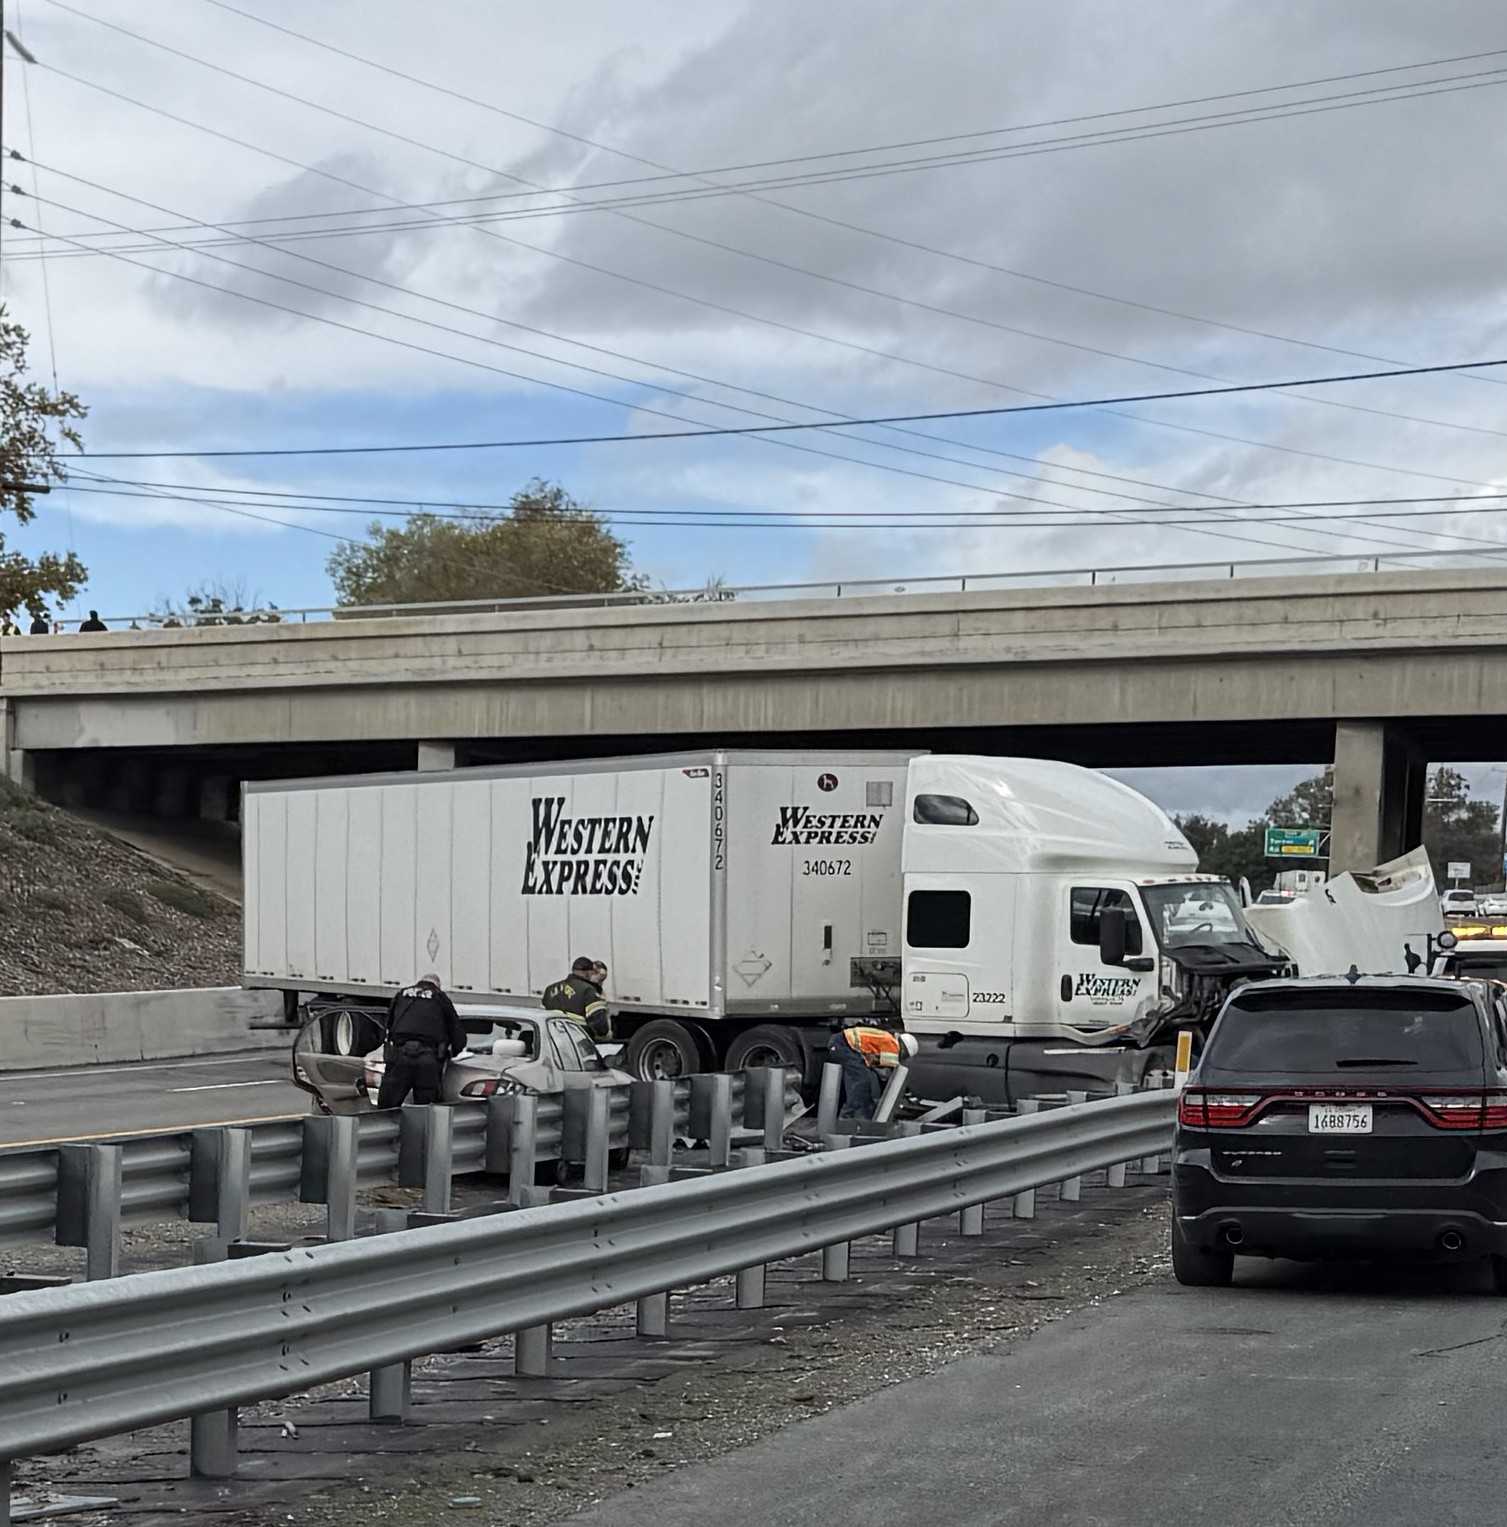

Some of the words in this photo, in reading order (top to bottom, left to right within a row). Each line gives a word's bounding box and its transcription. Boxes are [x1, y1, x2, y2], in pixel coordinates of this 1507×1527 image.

[531, 797, 654, 857] WESTERN
[714, 773, 724, 870] 340672
[771, 824, 870, 845] EXPRESS
[779, 806, 883, 829] WESTERN
[521, 841, 635, 895] EXPRESS
[803, 860, 851, 876] 340672
